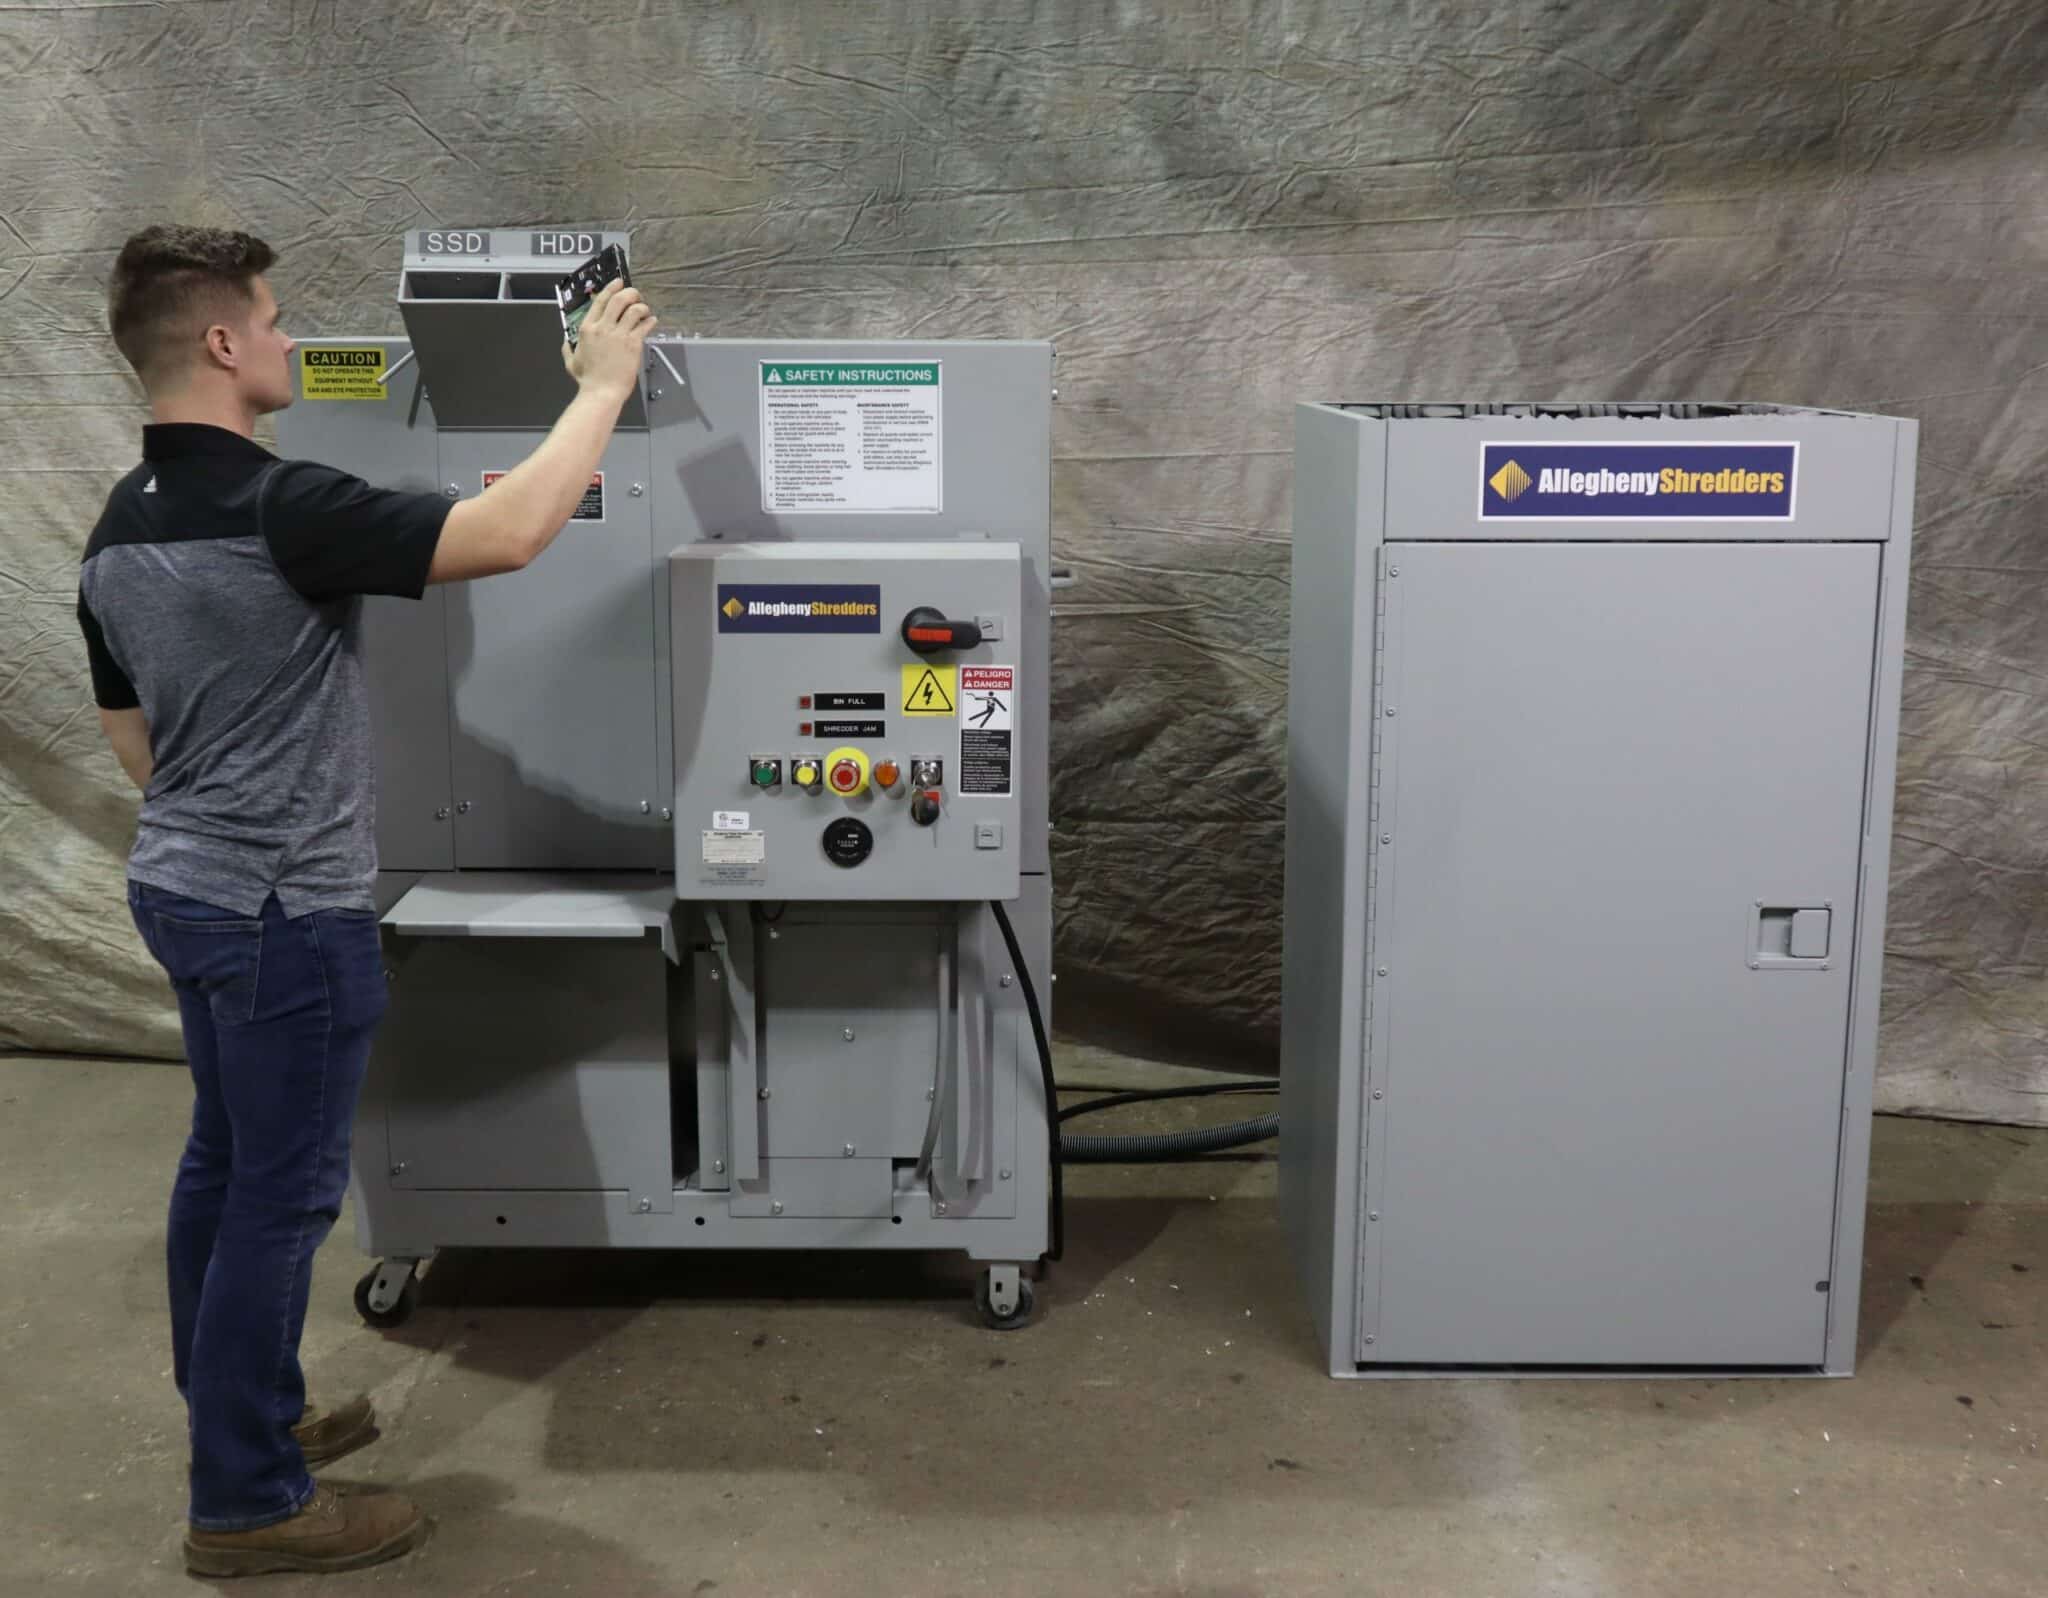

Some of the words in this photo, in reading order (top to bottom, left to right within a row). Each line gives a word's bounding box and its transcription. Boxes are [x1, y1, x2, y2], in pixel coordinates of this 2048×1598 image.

[427, 232, 483, 254] SSD
[539, 234, 594, 255] HDD
[310, 352, 376, 364] CAUTION
[785, 369, 835, 381] SAFETY
[838, 369, 932, 381] INSTRUCTIONS
[1538, 468, 1784, 497] AlleghenyShredders
[748, 601, 877, 617] AlleghenyShredders
[974, 670, 1011, 678] PELIGRO
[973, 680, 1010, 688] DANGER
